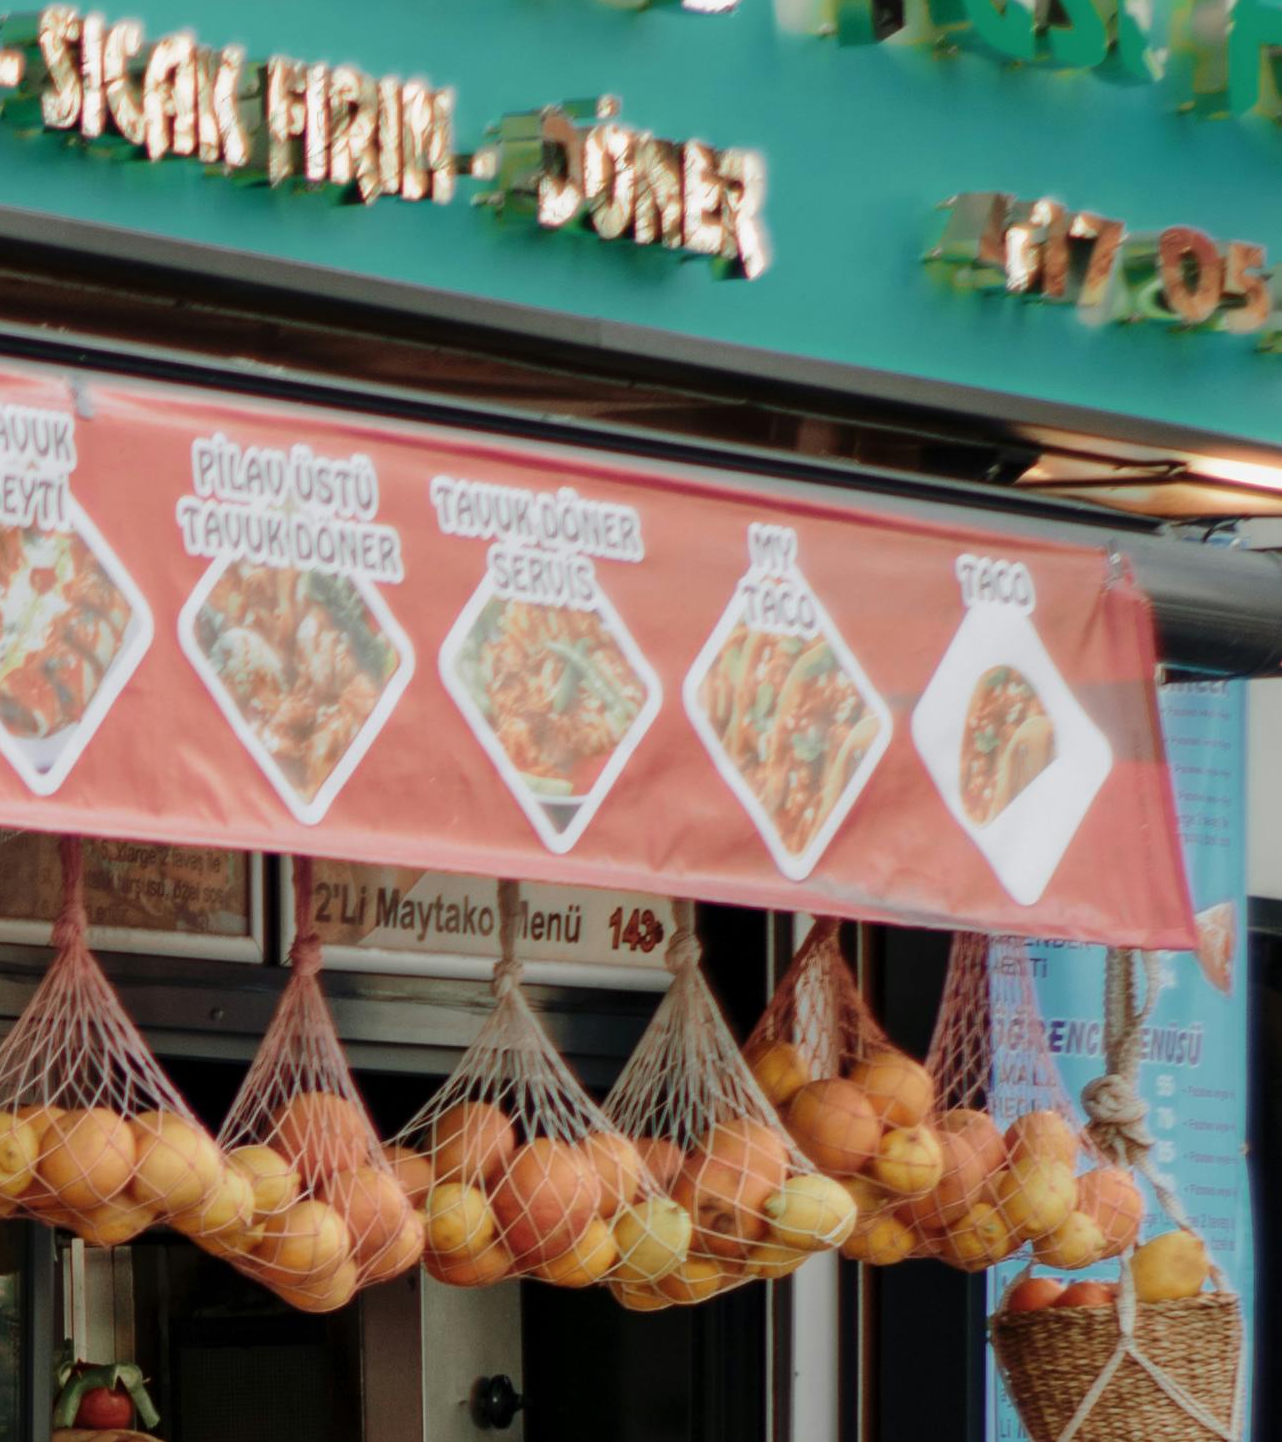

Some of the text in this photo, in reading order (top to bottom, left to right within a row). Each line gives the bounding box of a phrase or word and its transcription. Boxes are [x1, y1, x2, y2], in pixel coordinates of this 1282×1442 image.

[197, 436, 375, 512] PİLAV ÜSTÜ
[182, 505, 399, 578] TAVUK DÖNER
[436, 483, 638, 553] TAVUK DÖNER
[741, 584, 818, 633] TACO
[958, 562, 1033, 606] TACO
[374, 886, 495, 944] Maytako
[1139, 1023, 1204, 1066] ENÜSÜ
